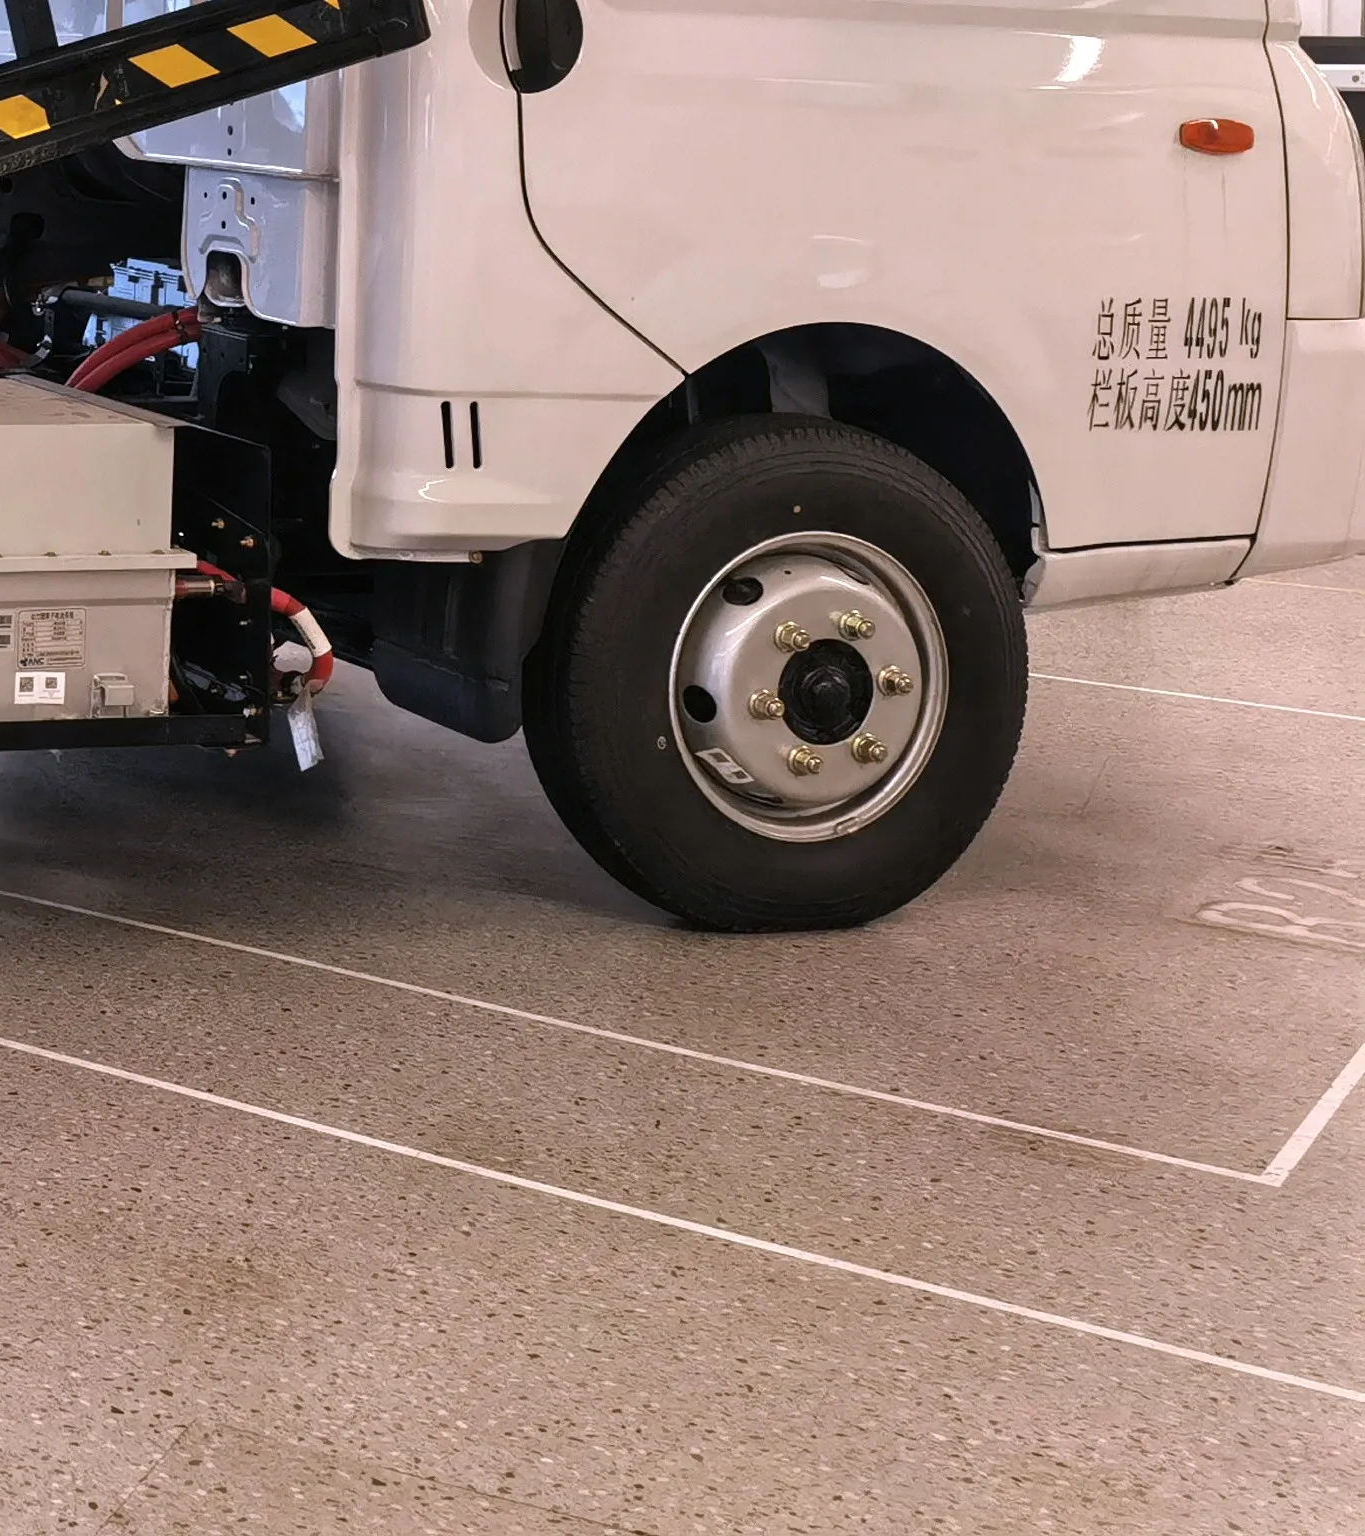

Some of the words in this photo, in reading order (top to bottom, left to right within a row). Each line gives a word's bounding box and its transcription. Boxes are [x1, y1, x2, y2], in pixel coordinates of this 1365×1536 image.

[1092, 296, 1171, 360] 总质量
[1183, 296, 1231, 359] 4495
[1239, 296, 1262, 359] kg
